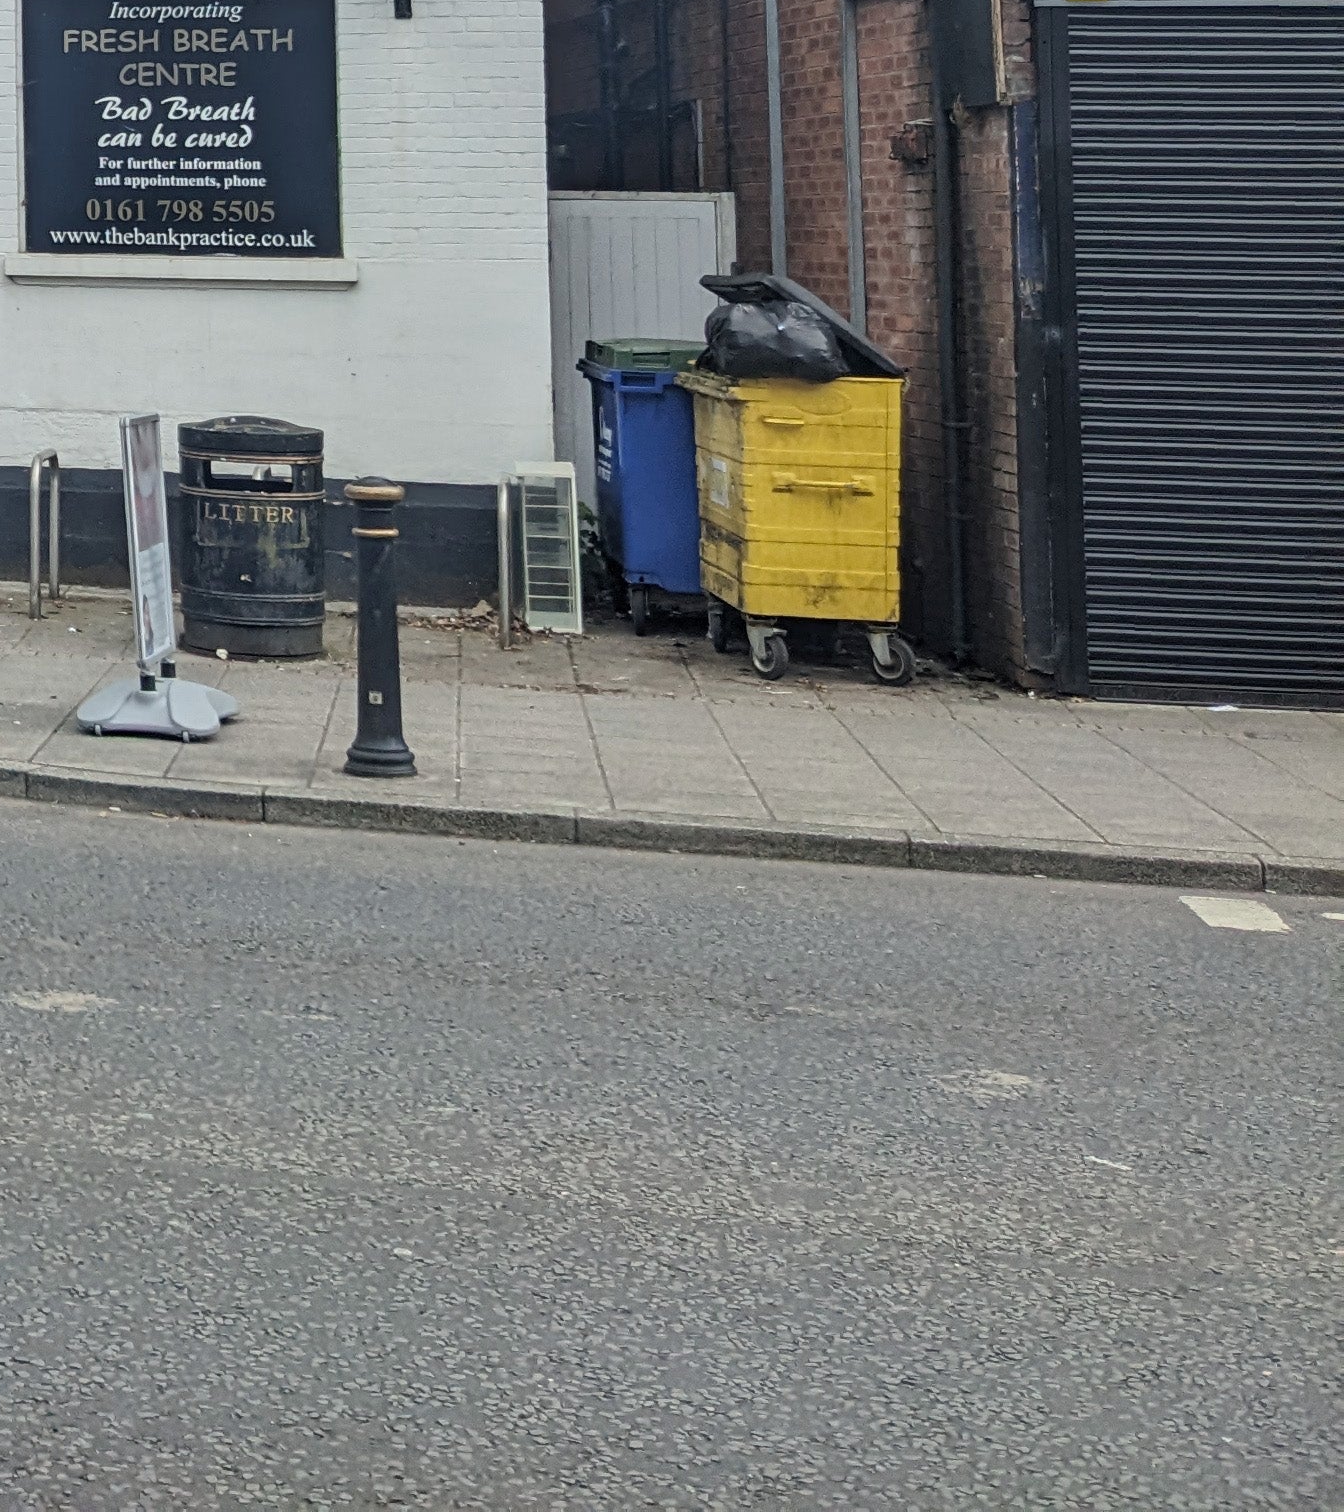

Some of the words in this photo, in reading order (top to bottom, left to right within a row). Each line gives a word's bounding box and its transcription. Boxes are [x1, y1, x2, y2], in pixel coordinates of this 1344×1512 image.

[108, 2, 243, 23] Incorporating
[63, 29, 159, 53] FRESH
[173, 29, 293, 53] BREATH
[119, 62, 236, 87] CENTRE
[94, 96, 152, 120] Bad
[160, 96, 255, 121] Breath
[97, 130, 142, 148] can
[151, 124, 177, 148] be
[184, 125, 253, 148] cured
[98, 158, 124, 170] For
[127, 158, 177, 170] further
[180, 158, 261, 170] information
[95, 175, 120, 186] and
[124, 175, 221, 189] appointments,
[224, 175, 266, 189] phone
[86, 199, 145, 221] 0161
[158, 200, 202, 221] 798
[212, 201, 275, 222] 5505
[50, 228, 315, 250] www.thebankpractice.co.uk
[204, 502, 294, 523] LITTER
